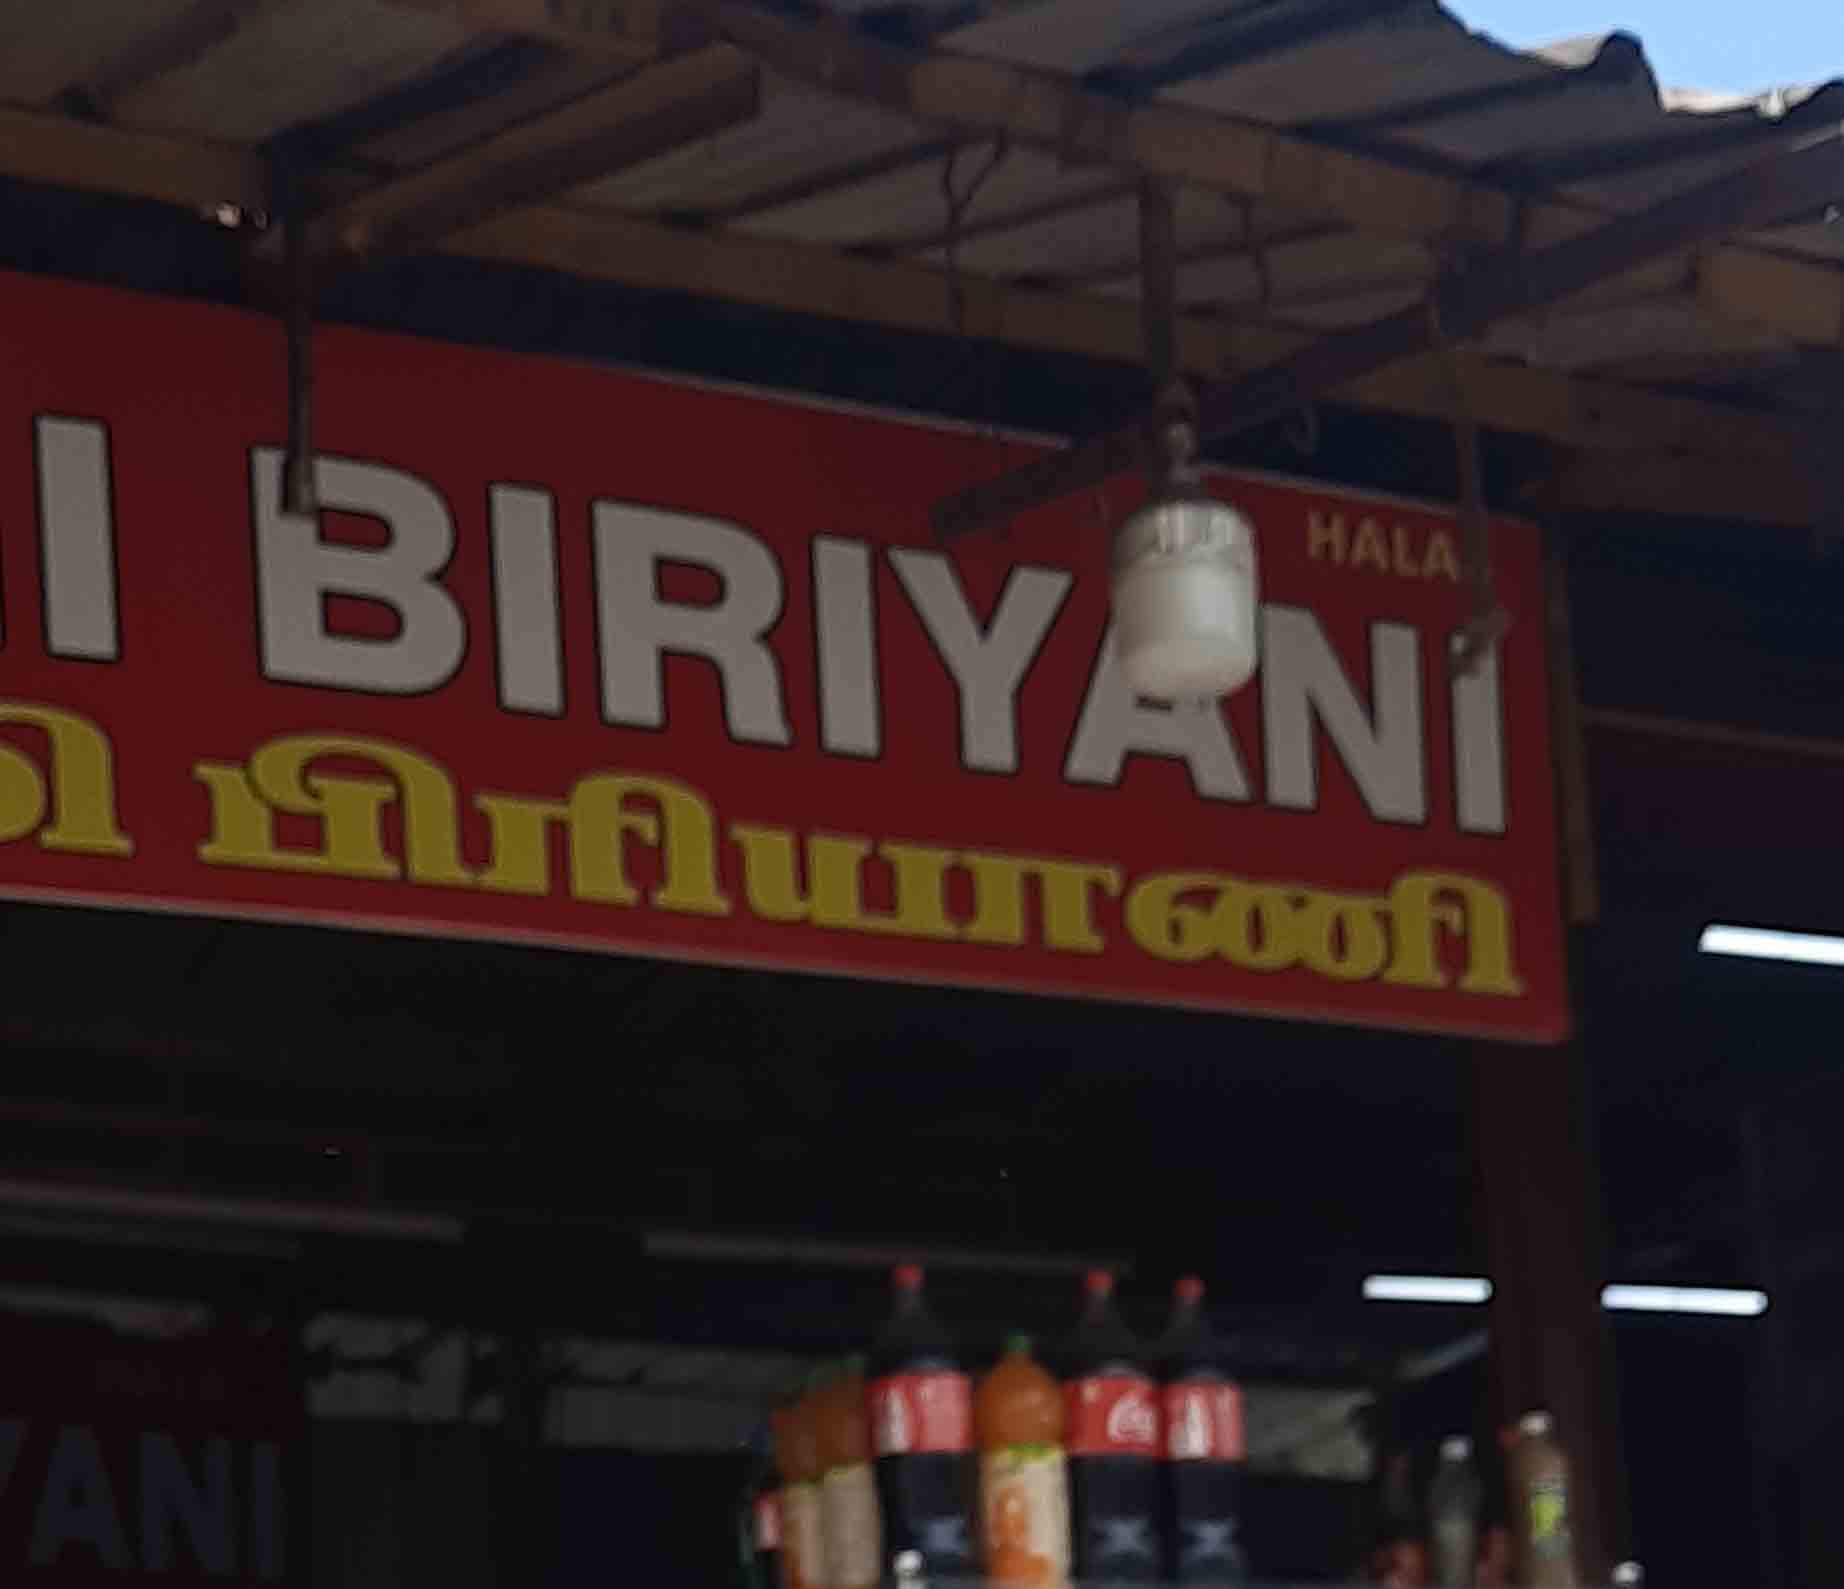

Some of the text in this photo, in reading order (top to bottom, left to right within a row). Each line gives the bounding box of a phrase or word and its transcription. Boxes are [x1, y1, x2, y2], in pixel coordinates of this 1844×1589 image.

[248, 444, 1509, 837] BIRIYANI
[1305, 511, 1459, 583] HALA
[192, 732, 1525, 999] பிரியாணி
